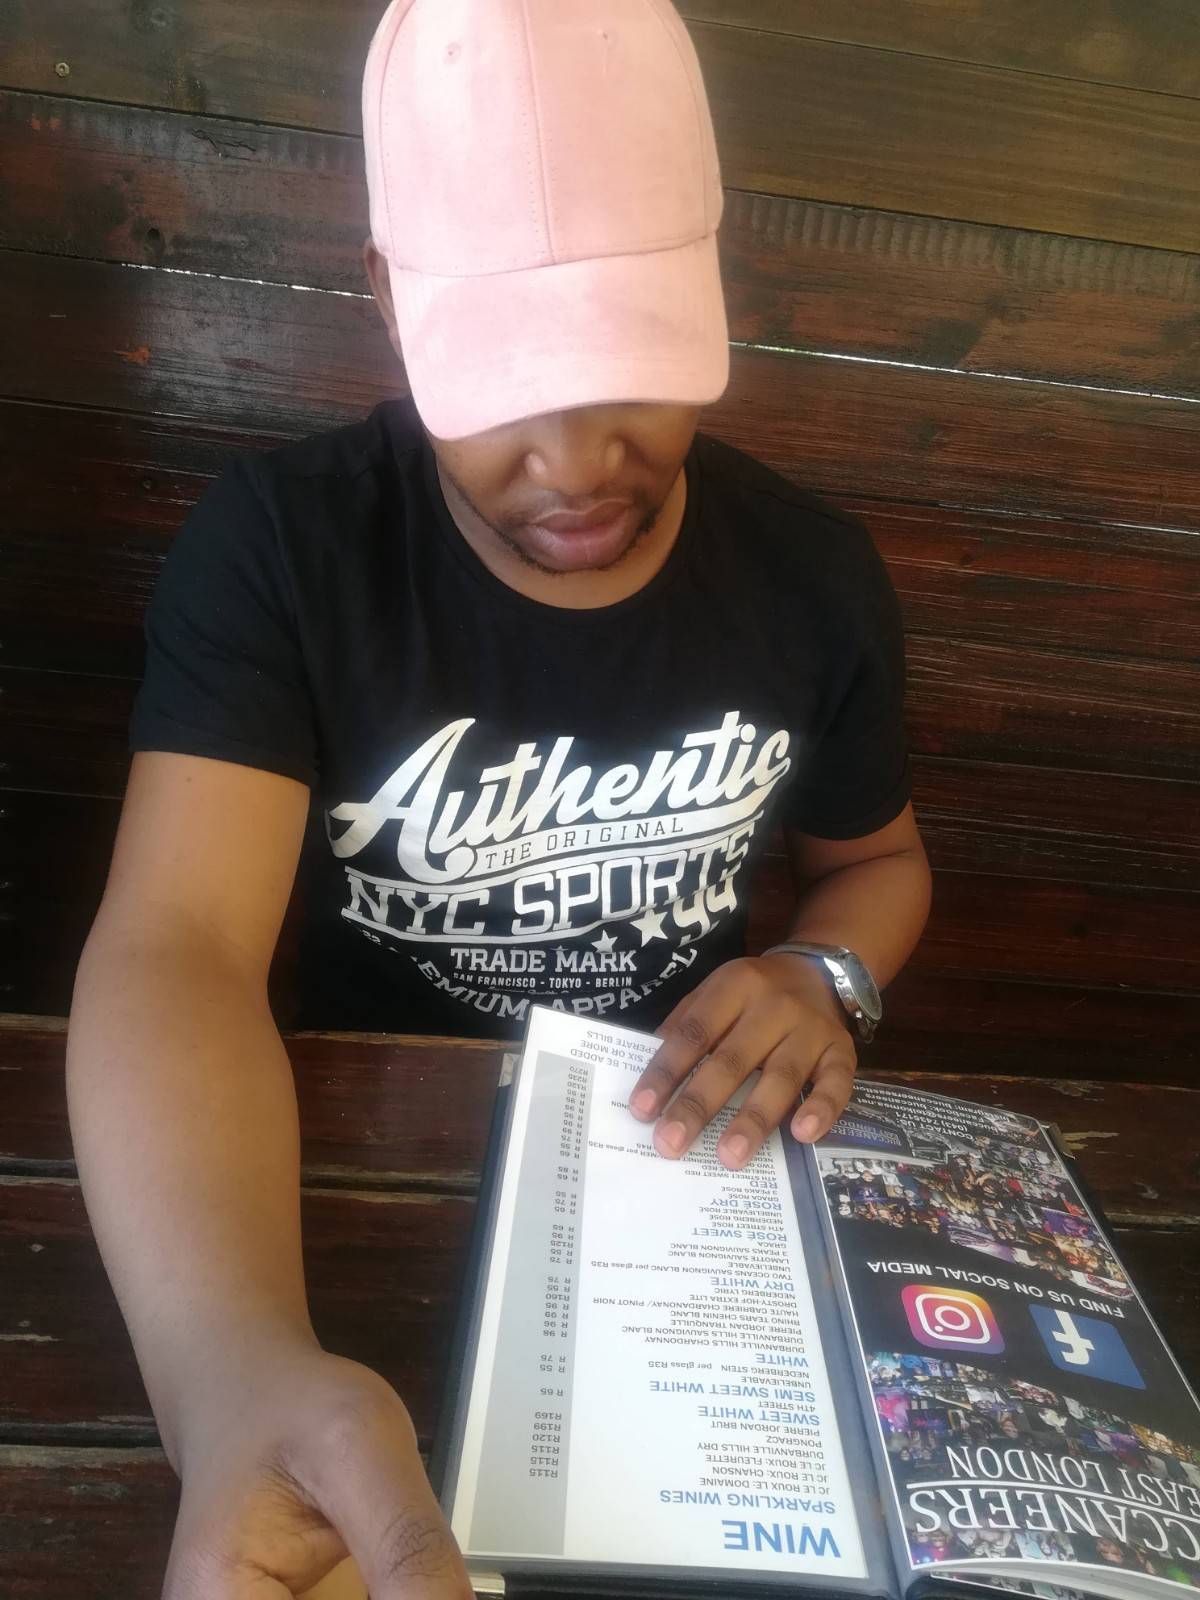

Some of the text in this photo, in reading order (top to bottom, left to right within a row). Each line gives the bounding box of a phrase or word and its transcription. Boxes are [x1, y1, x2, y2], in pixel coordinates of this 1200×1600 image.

[325, 711, 791, 885] Authentic
[486, 817, 684, 869] THE ORIGINAL
[347, 873, 490, 935] NYC
[451, 948, 638, 973] TRADE MARK
[478, 976, 536, 988] FRANCISCO
[549, 977, 581, 988] TOKYO
[595, 977, 632, 988] BERLIN
[587, 1030, 613, 1043] BILLS
[580, 1040, 643, 1062] SIX OR MORE
[570, 1048, 644, 1073] WILL BE ADDED
[920, 1123, 974, 1140] CONTACT
[749, 1180, 777, 1189] RED
[709, 1198, 738, 1207] DRY
[691, 1227, 742, 1238] SWEET
[671, 1243, 698, 1251] BLANC
[701, 1245, 749, 1253] SAUVIGNON
[699, 1253, 748, 1261] SAUVIGNON
[751, 1256, 789, 1264] LAMOTTE
[651, 1265, 679, 1273] BLANC
[682, 1267, 732, 1277] SAUVIGNON
[728, 1261, 790, 1272] UNBELIEVABLE
[735, 1270, 769, 1279] OCEANS
[772, 1273, 792, 1281] TWO
[710, 1276, 794, 1292] DRY WHITE
[866, 1261, 1125, 1318] FIND US ON SOCIAL MEDIA
[714, 1288, 795, 1300] NEDERBERG LYRIC
[593, 1298, 615, 1306] NOIR
[618, 1299, 644, 1308] PINOT
[710, 1296, 739, 1304] EXTRA
[723, 1306, 767, 1315] CABRIERE
[770, 1308, 799, 1317] HAUTE
[670, 1311, 800, 1326] RHINO TEARS CHENIN BLANC
[670, 1320, 802, 1335] PIERRE JORDAN TRANQUILLE
[622, 1326, 803, 1344] DURBANVILLE HILLS SAUVIGNON BLANC
[644, 1336, 804, 1353] DURBANVILLE HILLS CHARDONNAY
[671, 1361, 694, 1369] glass
[755, 1353, 808, 1367] WHITE
[697, 1362, 712, 1370] per
[721, 1364, 748, 1374] STEIN
[751, 1367, 809, 1378] NEDERBERG
[741, 1376, 811, 1388] UNBELIEVABLE
[650, 1381, 816, 1402] SEMI SWEET WHITE
[758, 1401, 816, 1412] 4TH STREET
[535, 1412, 562, 1420] R169
[698, 1406, 820, 1425] SWEET WHITE
[534, 1423, 561, 1431] R199
[711, 1421, 819, 1436] PIERRE JORDAN BRUT
[532, 1434, 560, 1443] R120
[766, 1436, 822, 1447] PONGRACZ
[531, 1445, 559, 1454] R115
[697, 1442, 824, 1459] DURBANVILLE HILLS DRY
[530, 1457, 559, 1466] R115
[706, 1455, 762, 1466] FLEURETTE
[766, 1459, 796, 1468] ROUX:
[800, 1461, 811, 1469] LE
[529, 1468, 558, 1478] R115
[713, 1467, 764, 1478] CHANSON
[767, 1471, 798, 1480] ROUX:
[802, 1473, 813, 1481] LE
[699, 1478, 749, 1489] DOMAINE
[943, 1445, 1200, 1518] EAST LONDON
[772, 1483, 800, 1492] ROUX
[803, 1485, 816, 1494] LE
[660, 1490, 835, 1514] SPARKLING WINES
[722, 1520, 841, 1558] WINE
